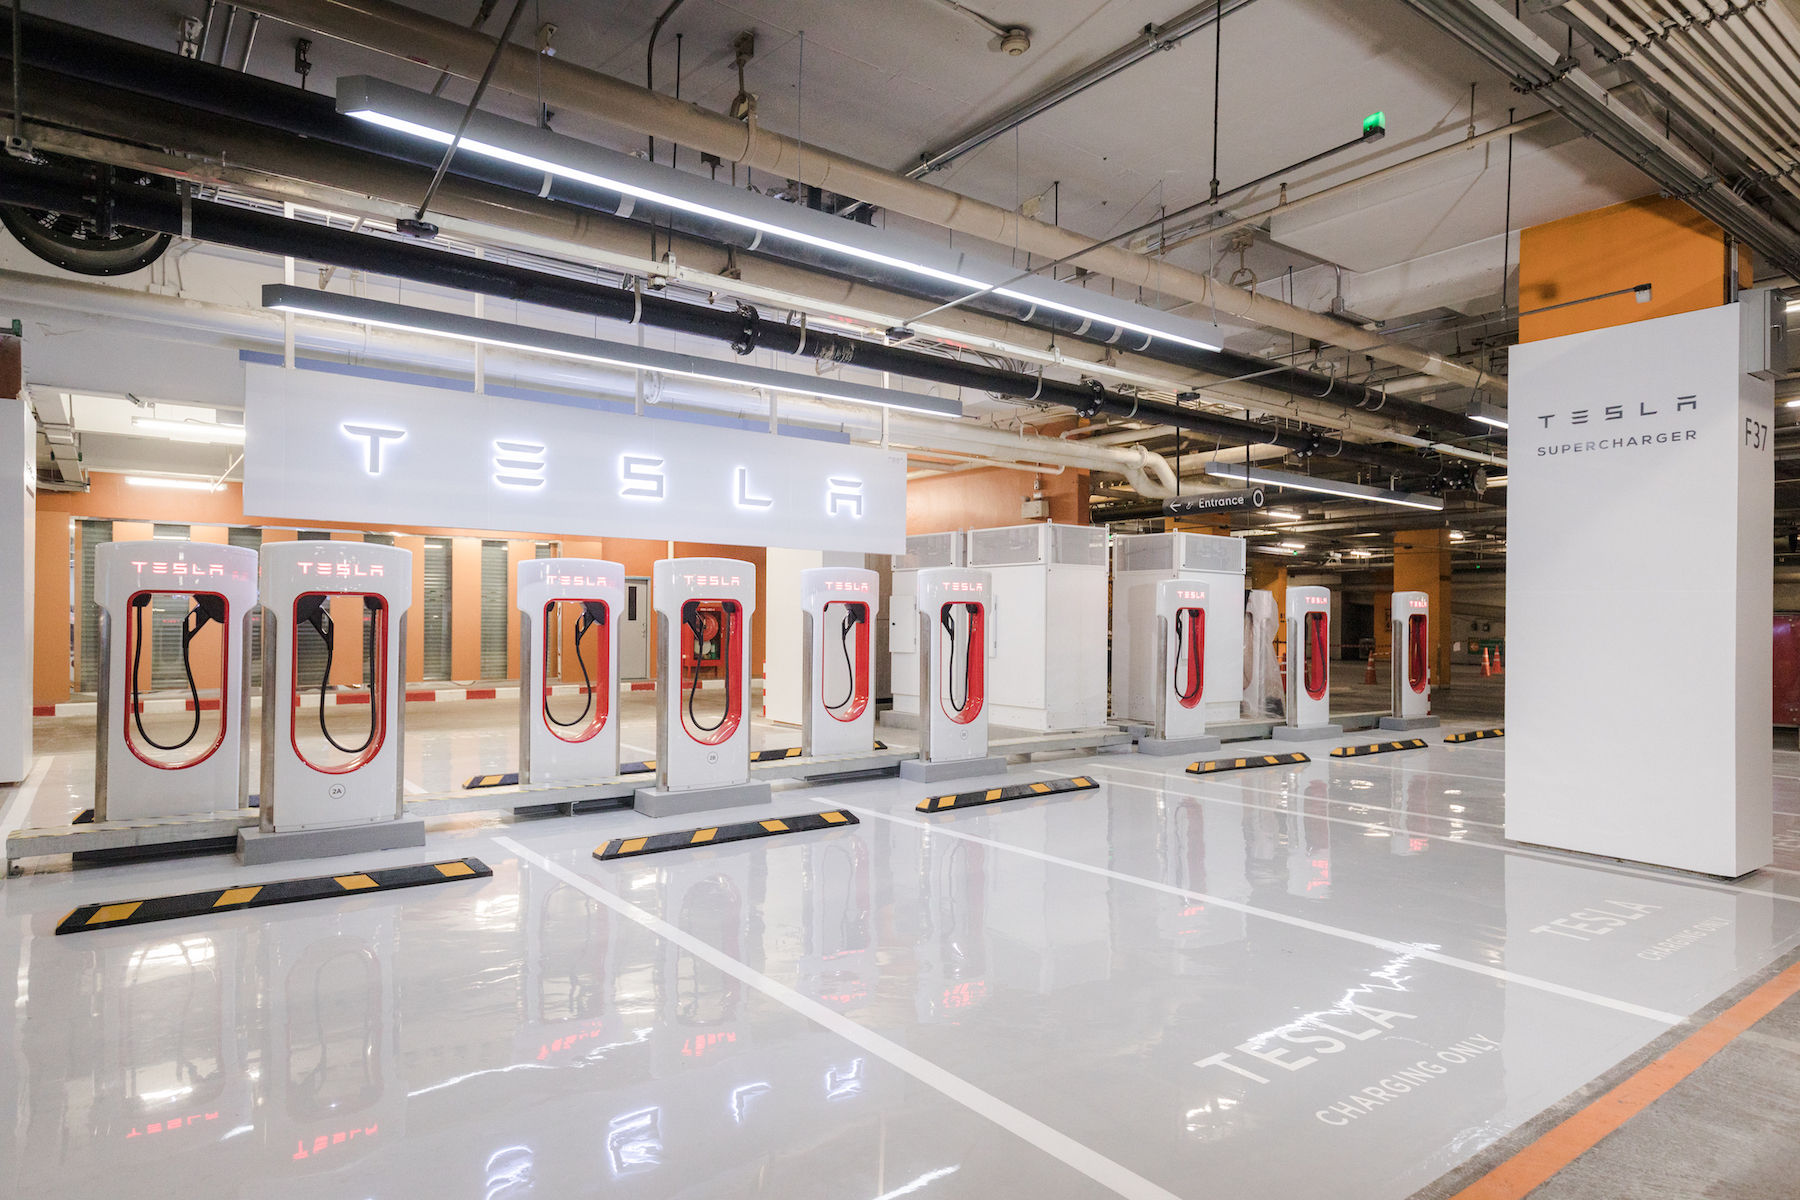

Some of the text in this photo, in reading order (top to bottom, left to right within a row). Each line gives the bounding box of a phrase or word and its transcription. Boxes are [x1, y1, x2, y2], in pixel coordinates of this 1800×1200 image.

[1538, 395, 1697, 428] TESLA
[1745, 417, 1768, 452] F37
[1537, 430, 1697, 457] SUPERCHARGER
[341, 423, 865, 518] TESLA
[1198, 496, 1245, 509] Entrance
[131, 561, 224, 576] TESLA
[297, 561, 385, 577] TESLA
[547, 575, 608, 586] TESLA
[684, 575, 741, 586] TESLA
[825, 581, 869, 592] TESLA
[942, 582, 984, 592] TESLA
[1177, 590, 1205, 599] TESLA
[1529, 900, 1662, 942] TESLA
[1193, 1003, 1418, 1085] TESLA
[1315, 1033, 1501, 1126] CHARGING ONLY
